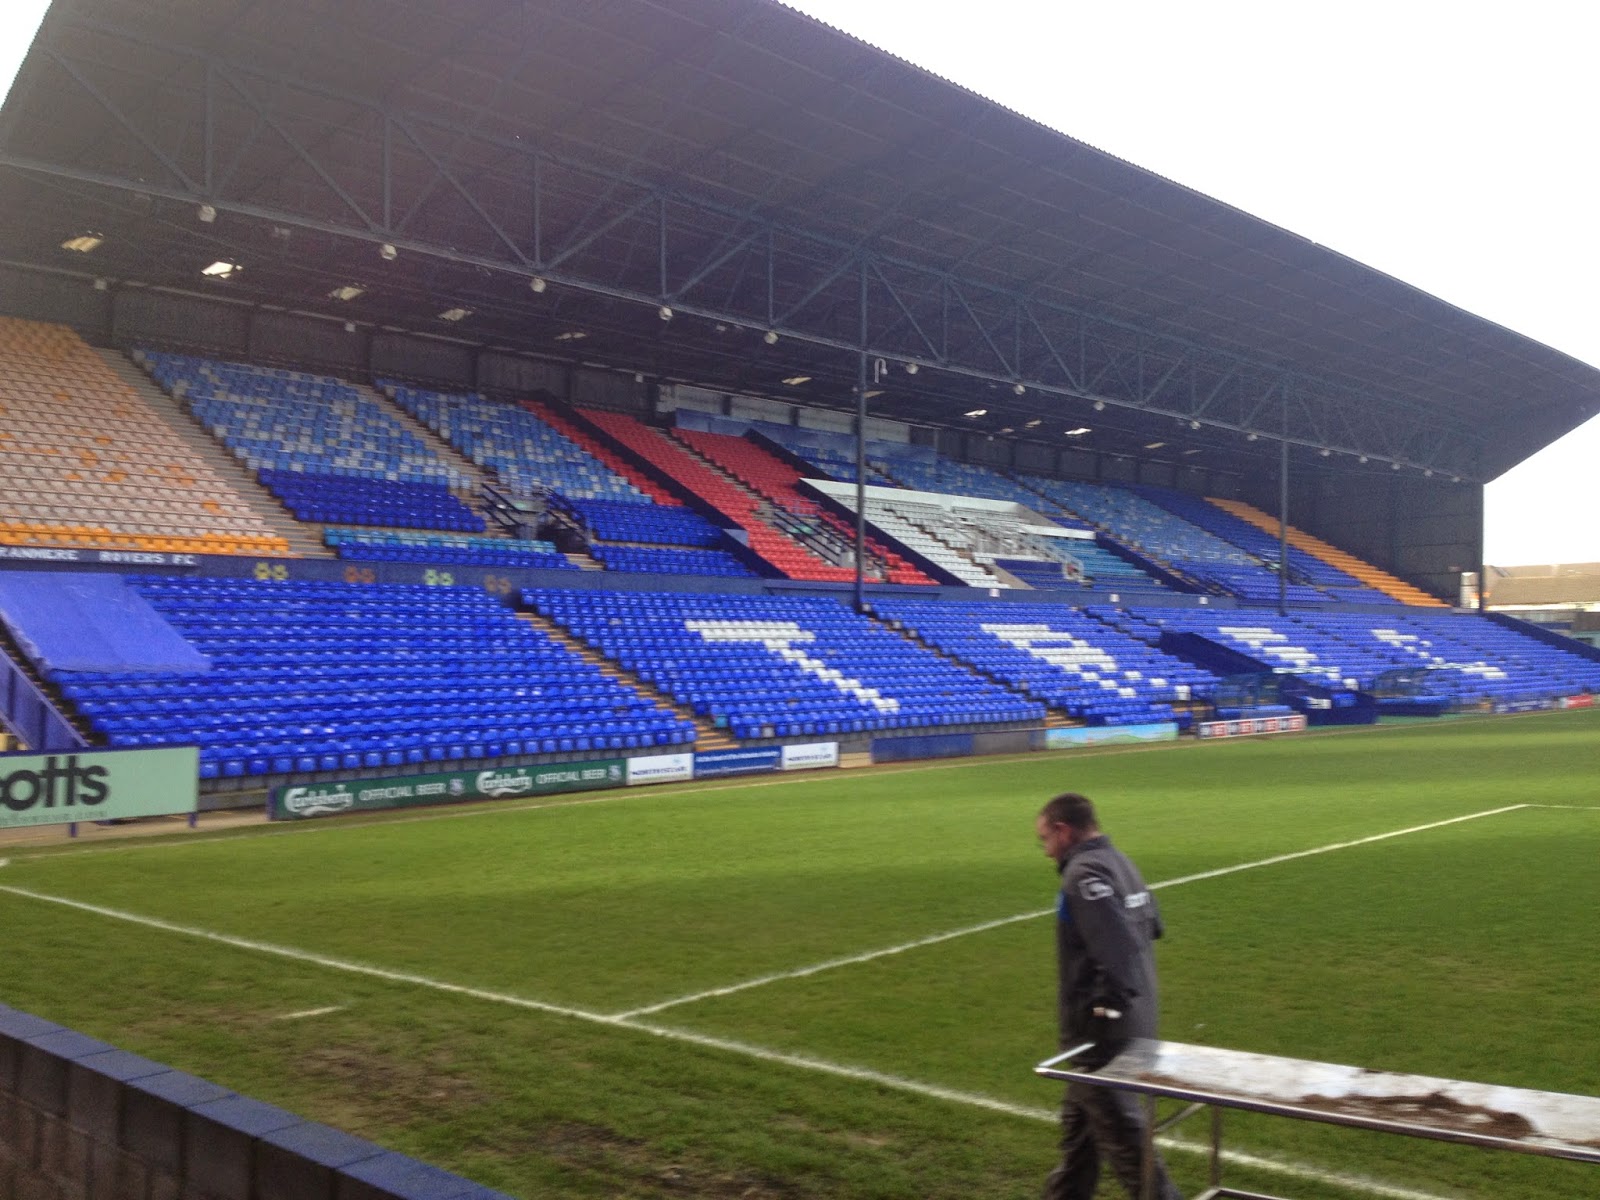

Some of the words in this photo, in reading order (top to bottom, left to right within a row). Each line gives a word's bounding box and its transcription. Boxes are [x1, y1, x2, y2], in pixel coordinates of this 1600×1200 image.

[172, 554, 196, 566] FC
[581, 769, 607, 780] BEER
[0, 755, 109, 812] otts
[415, 783, 446, 795] BEER
